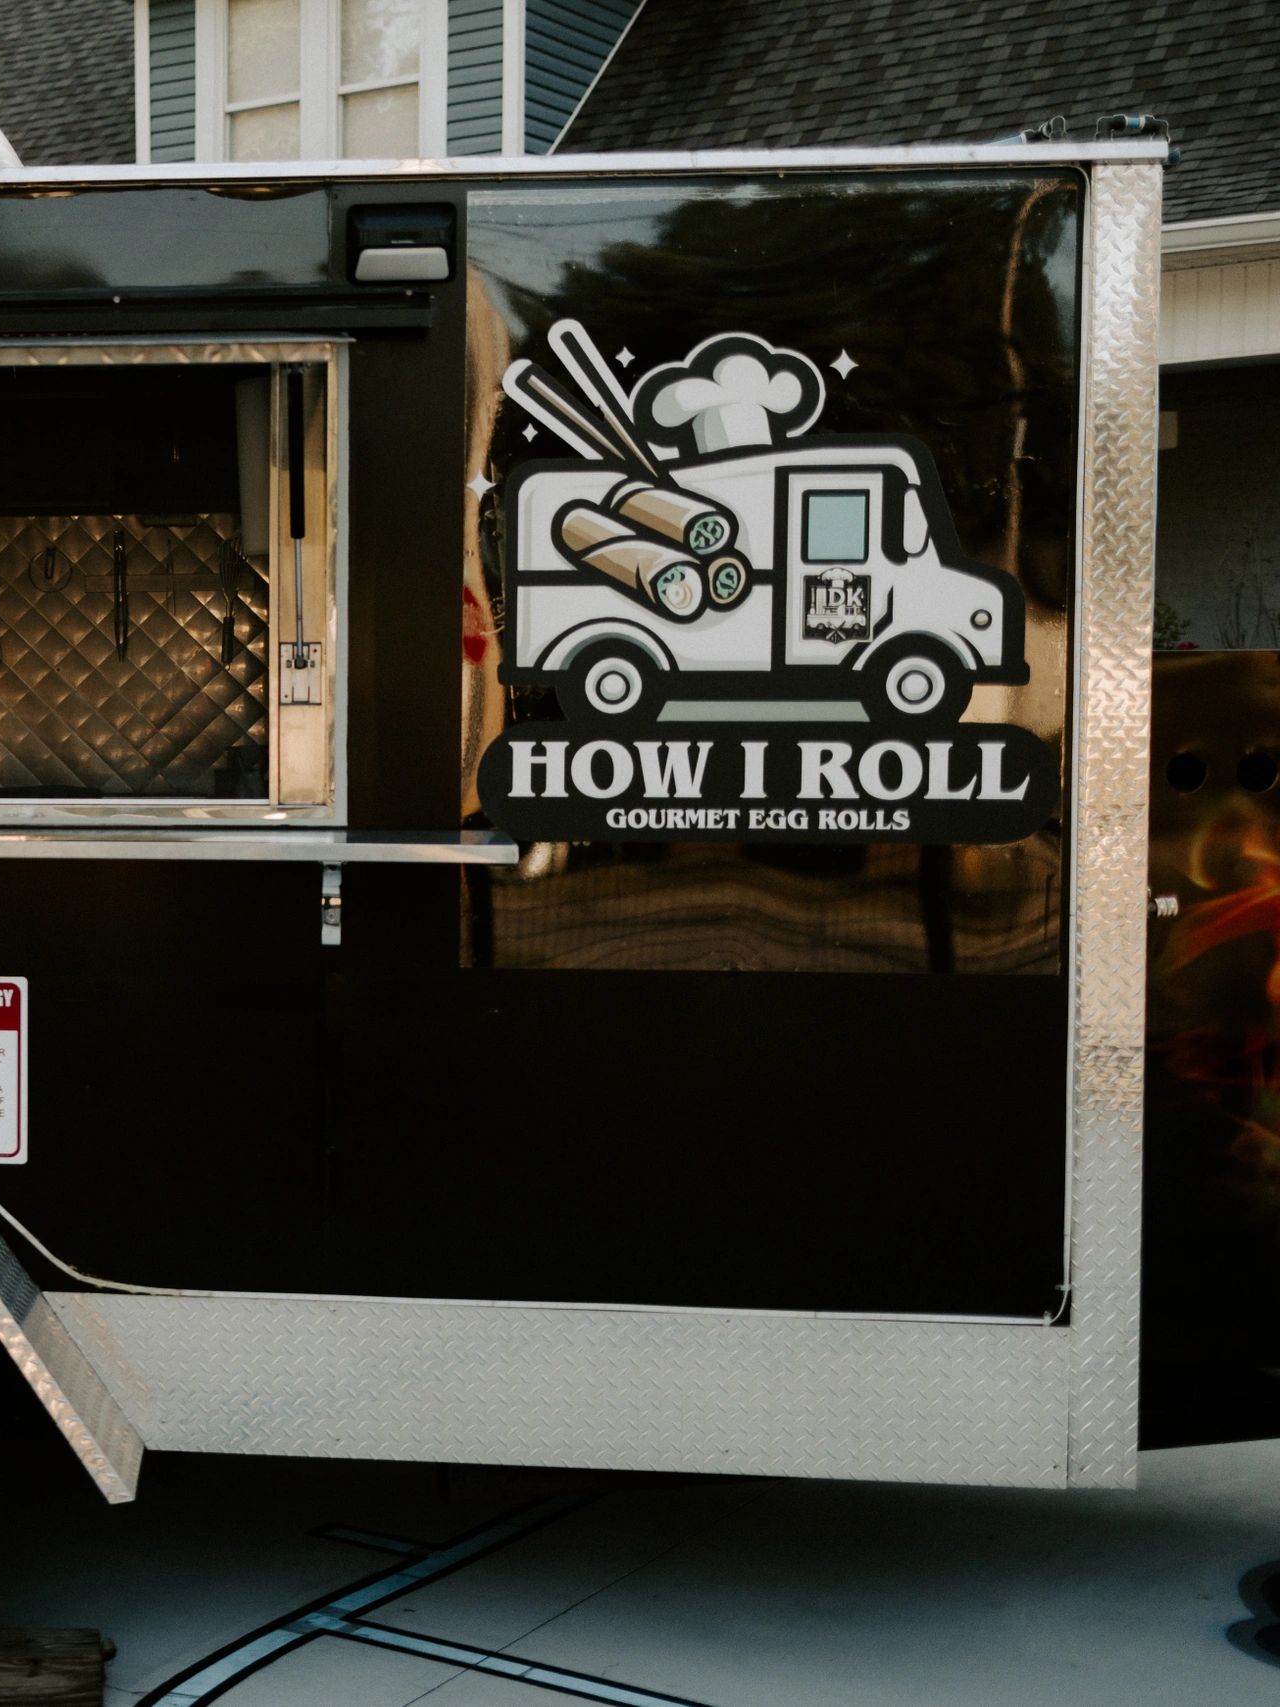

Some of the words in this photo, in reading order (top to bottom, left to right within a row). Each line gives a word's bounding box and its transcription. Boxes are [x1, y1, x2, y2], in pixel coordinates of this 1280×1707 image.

[507, 740, 715, 799] HOW
[739, 741, 769, 799] I
[795, 740, 1031, 801] ROLL
[605, 808, 741, 830] GOURMET
[748, 808, 809, 830] EGG
[818, 808, 911, 831] ROLLS
